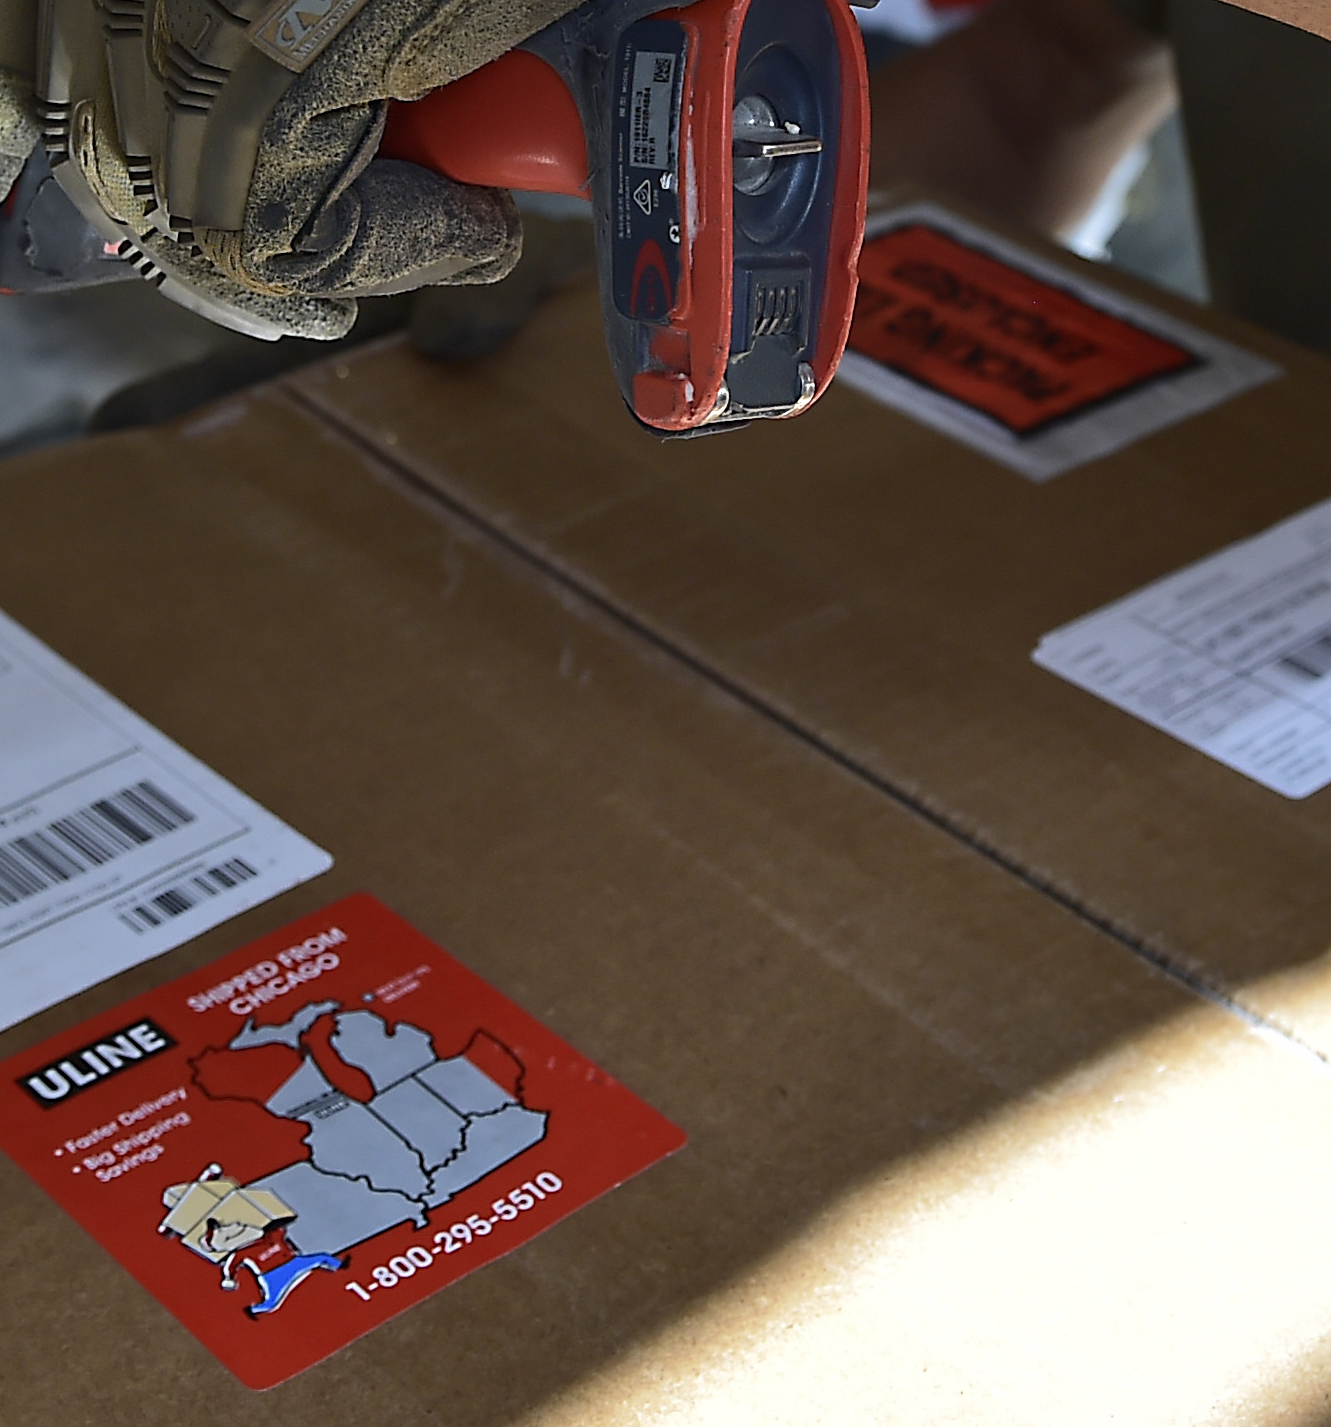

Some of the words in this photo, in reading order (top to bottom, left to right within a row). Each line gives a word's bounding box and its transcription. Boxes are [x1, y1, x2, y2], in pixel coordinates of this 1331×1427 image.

[186, 959, 279, 1014] SHIPPED
[277, 926, 348, 969] FROM
[228, 952, 340, 1016] CHICAGO
[27, 1023, 167, 1102] ULINE
[64, 1117, 119, 1155] Faster
[118, 1086, 188, 1127] Delivery
[83, 1141, 116, 1172] Big
[113, 1110, 192, 1157] Shipping
[94, 1142, 166, 1184] Savings
[344, 1169, 564, 1304] 1-800-295-5510
